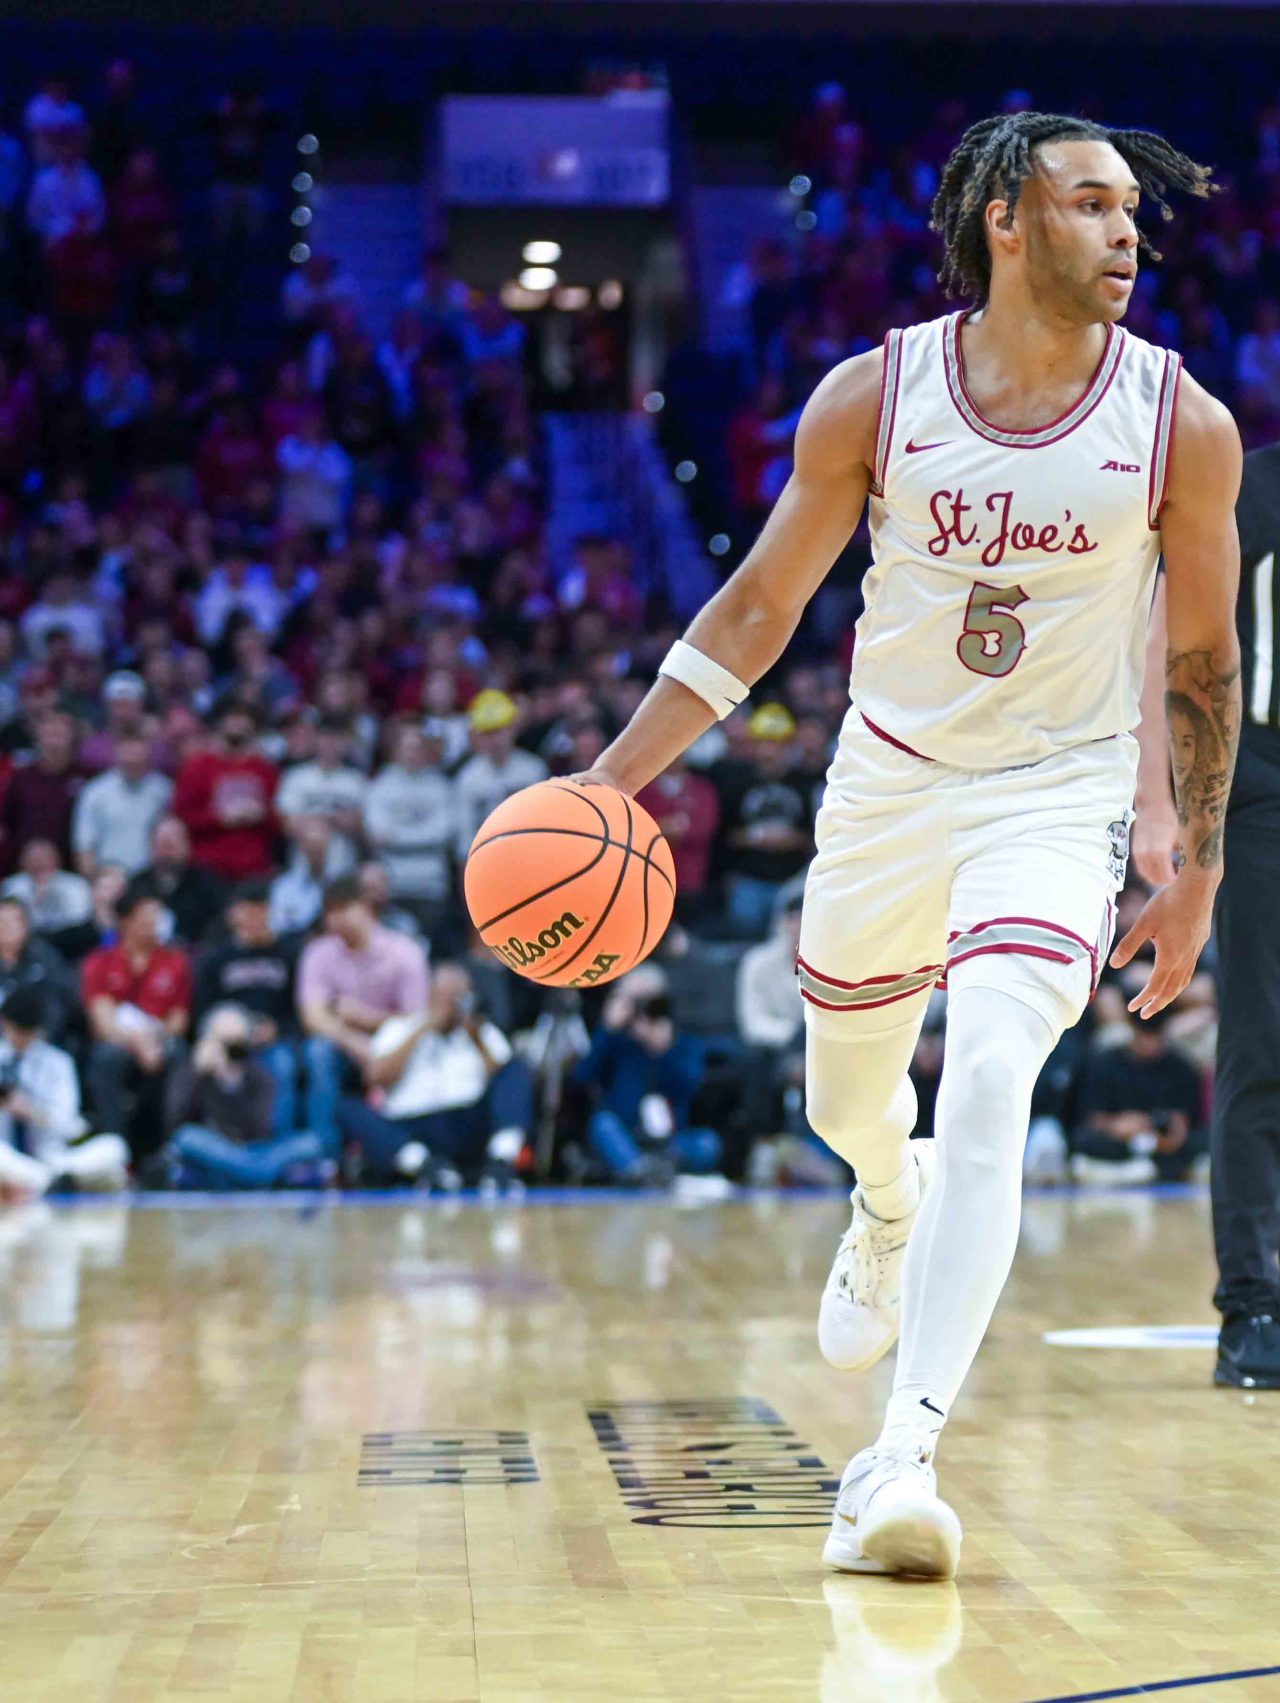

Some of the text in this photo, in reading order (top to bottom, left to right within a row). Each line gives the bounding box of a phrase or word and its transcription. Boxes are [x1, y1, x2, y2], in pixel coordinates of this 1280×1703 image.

[928, 488, 1099, 567] St. Joe's
[957, 581, 1031, 678] 5
